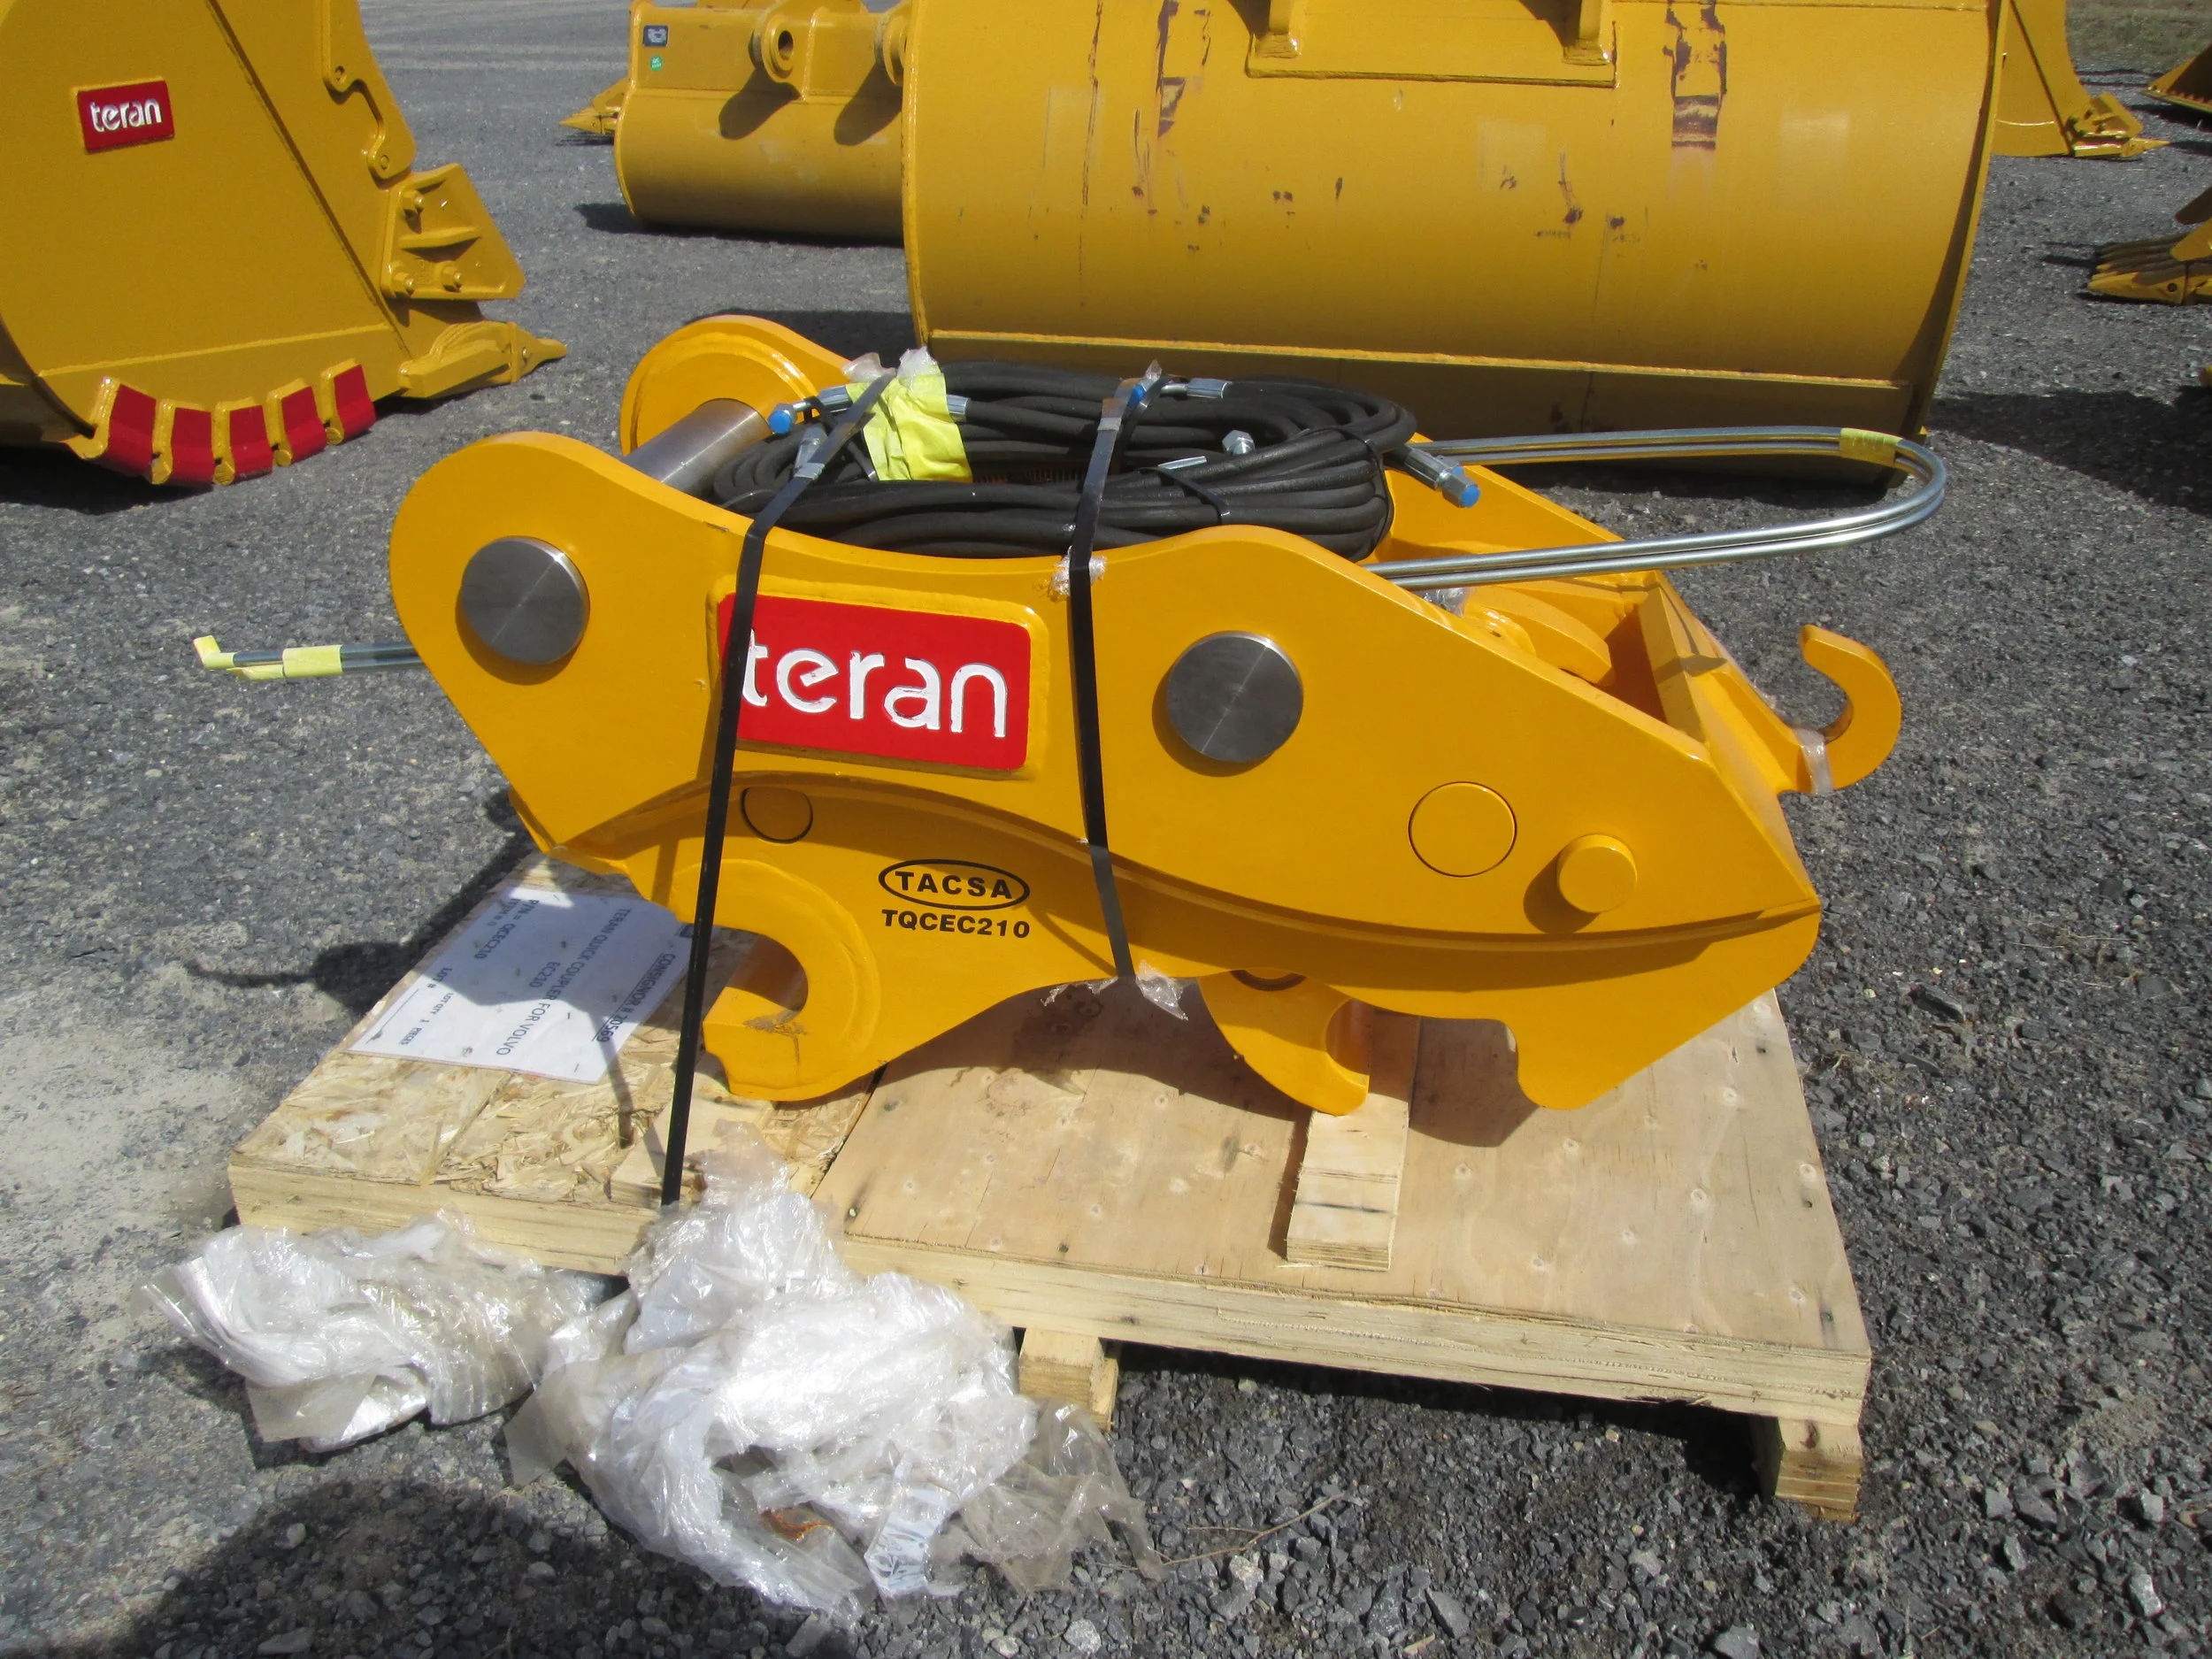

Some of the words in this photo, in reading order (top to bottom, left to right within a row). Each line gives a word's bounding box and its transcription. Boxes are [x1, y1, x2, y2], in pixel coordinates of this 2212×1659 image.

[90, 97, 163, 133] teran
[741, 627, 1008, 738] teran
[895, 871, 1012, 899] TACSA
[601, 908, 633, 934] TERAN
[881, 909, 1030, 939] TQCEC210
[473, 923, 516, 960] QCEC210
[579, 934, 609, 961] QUICK
[529, 961, 561, 988] EC210
[542, 961, 585, 1001] COUPLER
[625, 953, 676, 1007] CONSIGNOR
[525, 1002, 550, 1022] FOR
[495, 1021, 535, 1056] VOLVO
[595, 1015, 628, 1042] 20569
